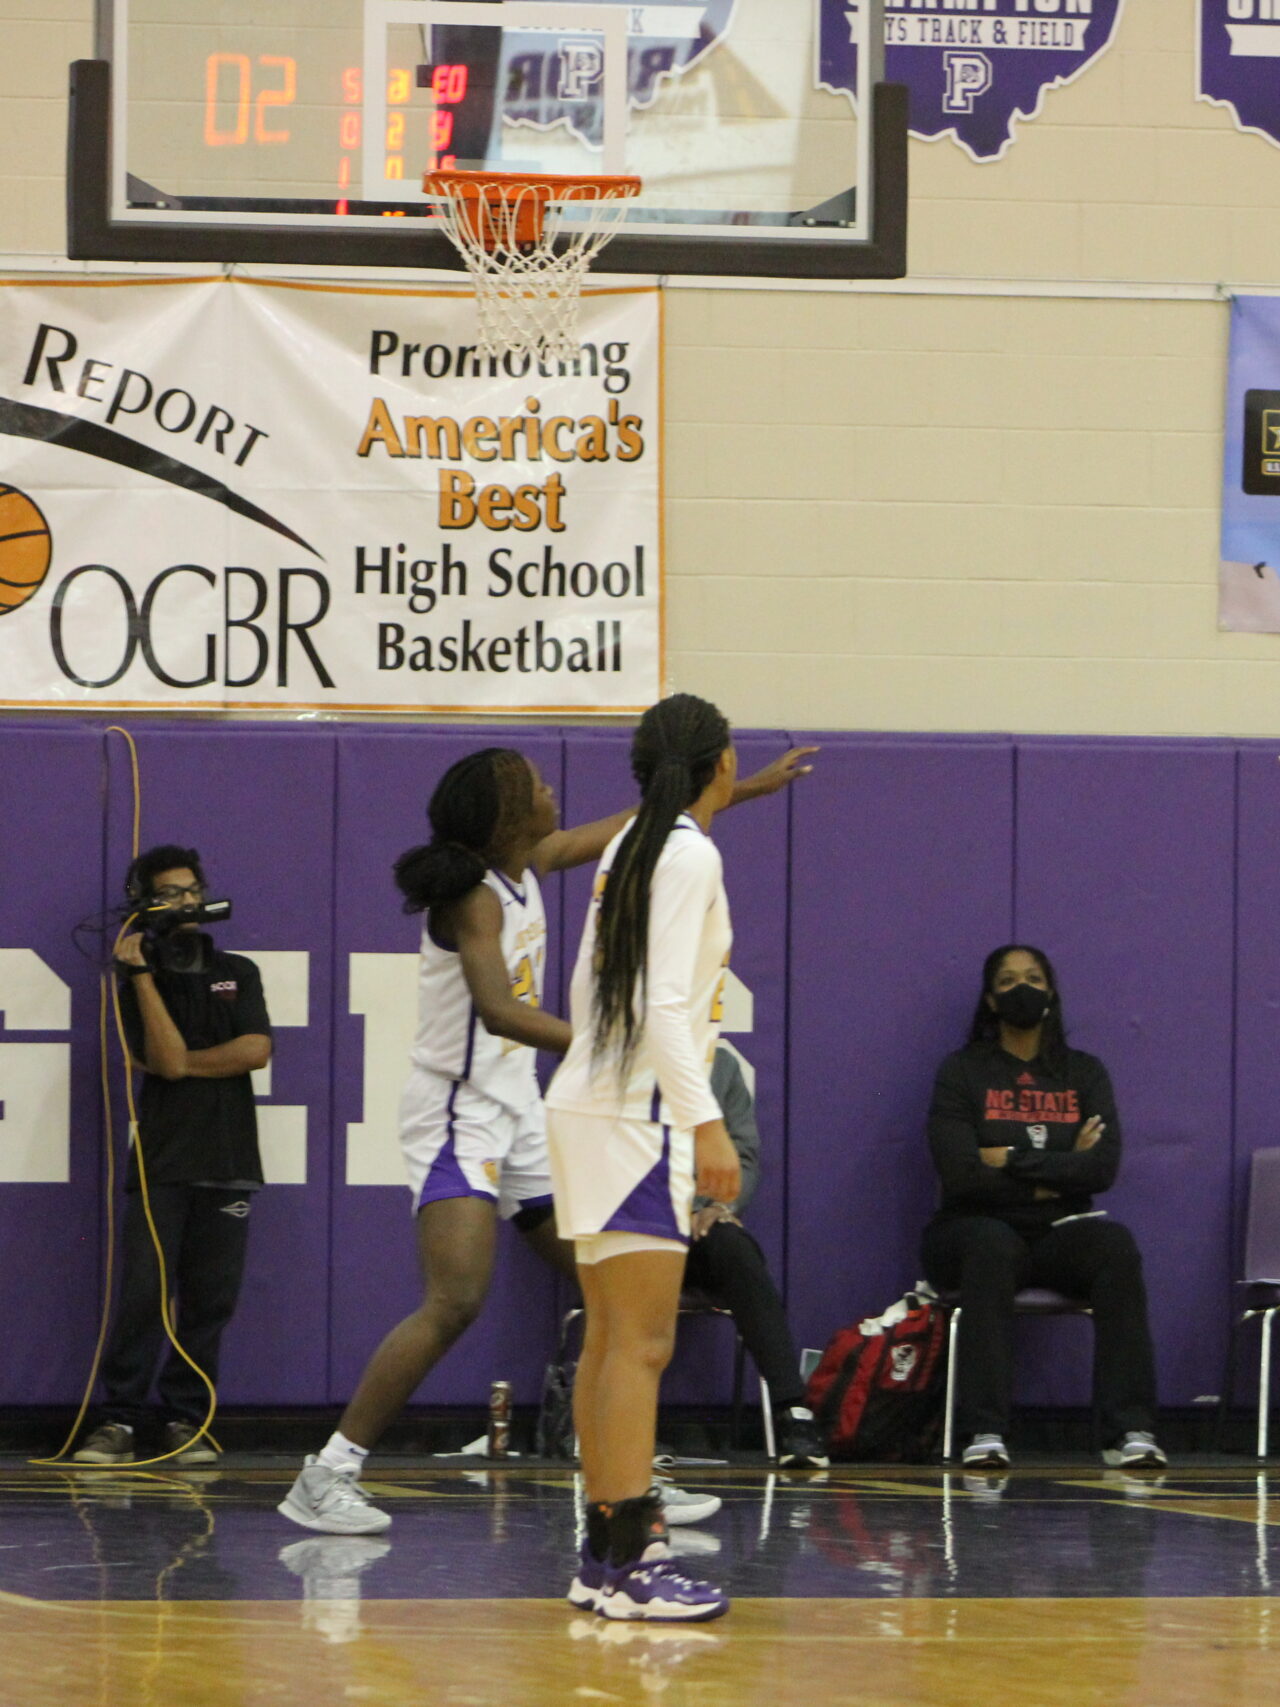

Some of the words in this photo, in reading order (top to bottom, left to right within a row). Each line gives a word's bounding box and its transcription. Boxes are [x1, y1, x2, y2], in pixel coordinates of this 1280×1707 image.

[918, 18, 983, 44] TRACK
[993, 19, 1009, 45] &
[1018, 21, 1075, 47] FIELD
[943, 51, 992, 113] P
[369, 330, 631, 394] Promoting
[22, 322, 270, 468] REPORT
[356, 396, 645, 463] America's
[437, 468, 567, 532] Best
[354, 543, 468, 614] High
[487, 544, 646, 598] School
[49, 563, 337, 690] OGBR
[377, 619, 623, 674] Basketball
[985, 1089, 1014, 1110] NC
[1019, 1089, 1080, 1112] STATE
